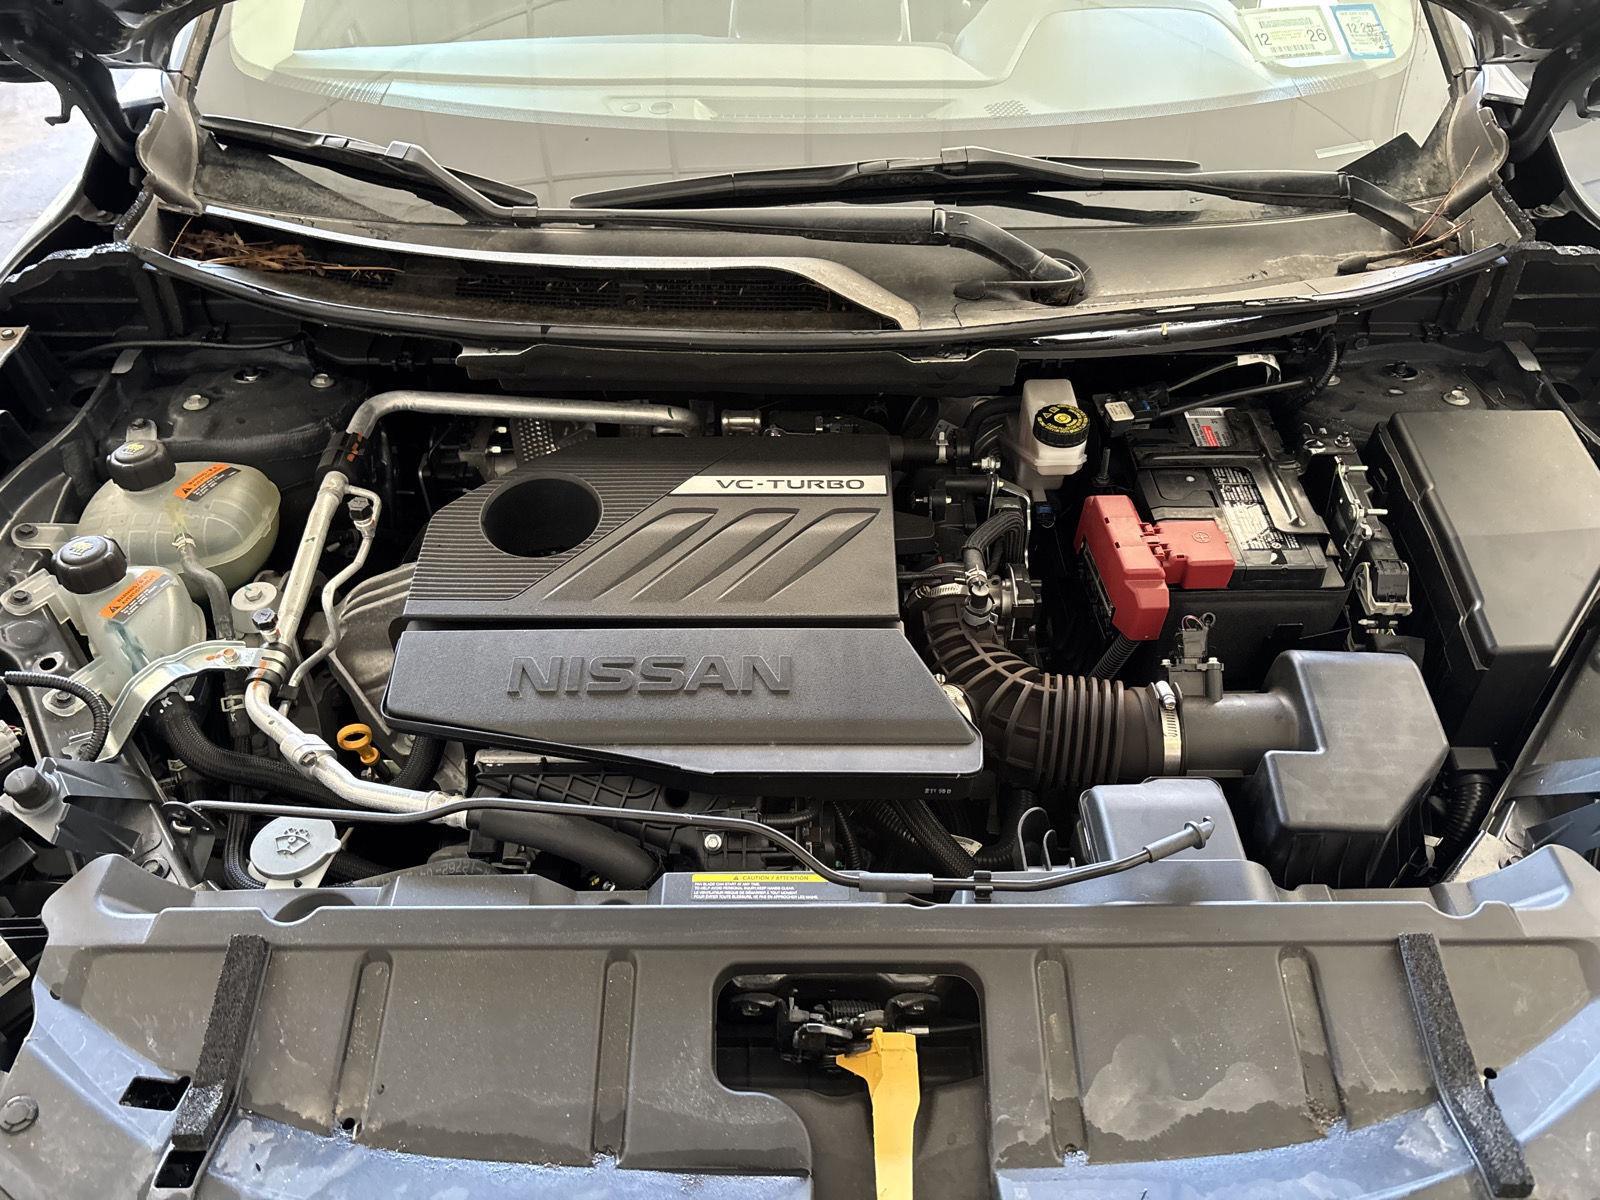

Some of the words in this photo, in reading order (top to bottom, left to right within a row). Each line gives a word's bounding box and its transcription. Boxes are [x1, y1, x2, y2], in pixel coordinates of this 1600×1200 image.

[1255, 32, 1272, 46] 12
[1306, 28, 1327, 42] 26
[715, 478, 865, 492] VC-TURBO
[506, 655, 794, 698] NISSAN
[160, 697, 173, 708] K
